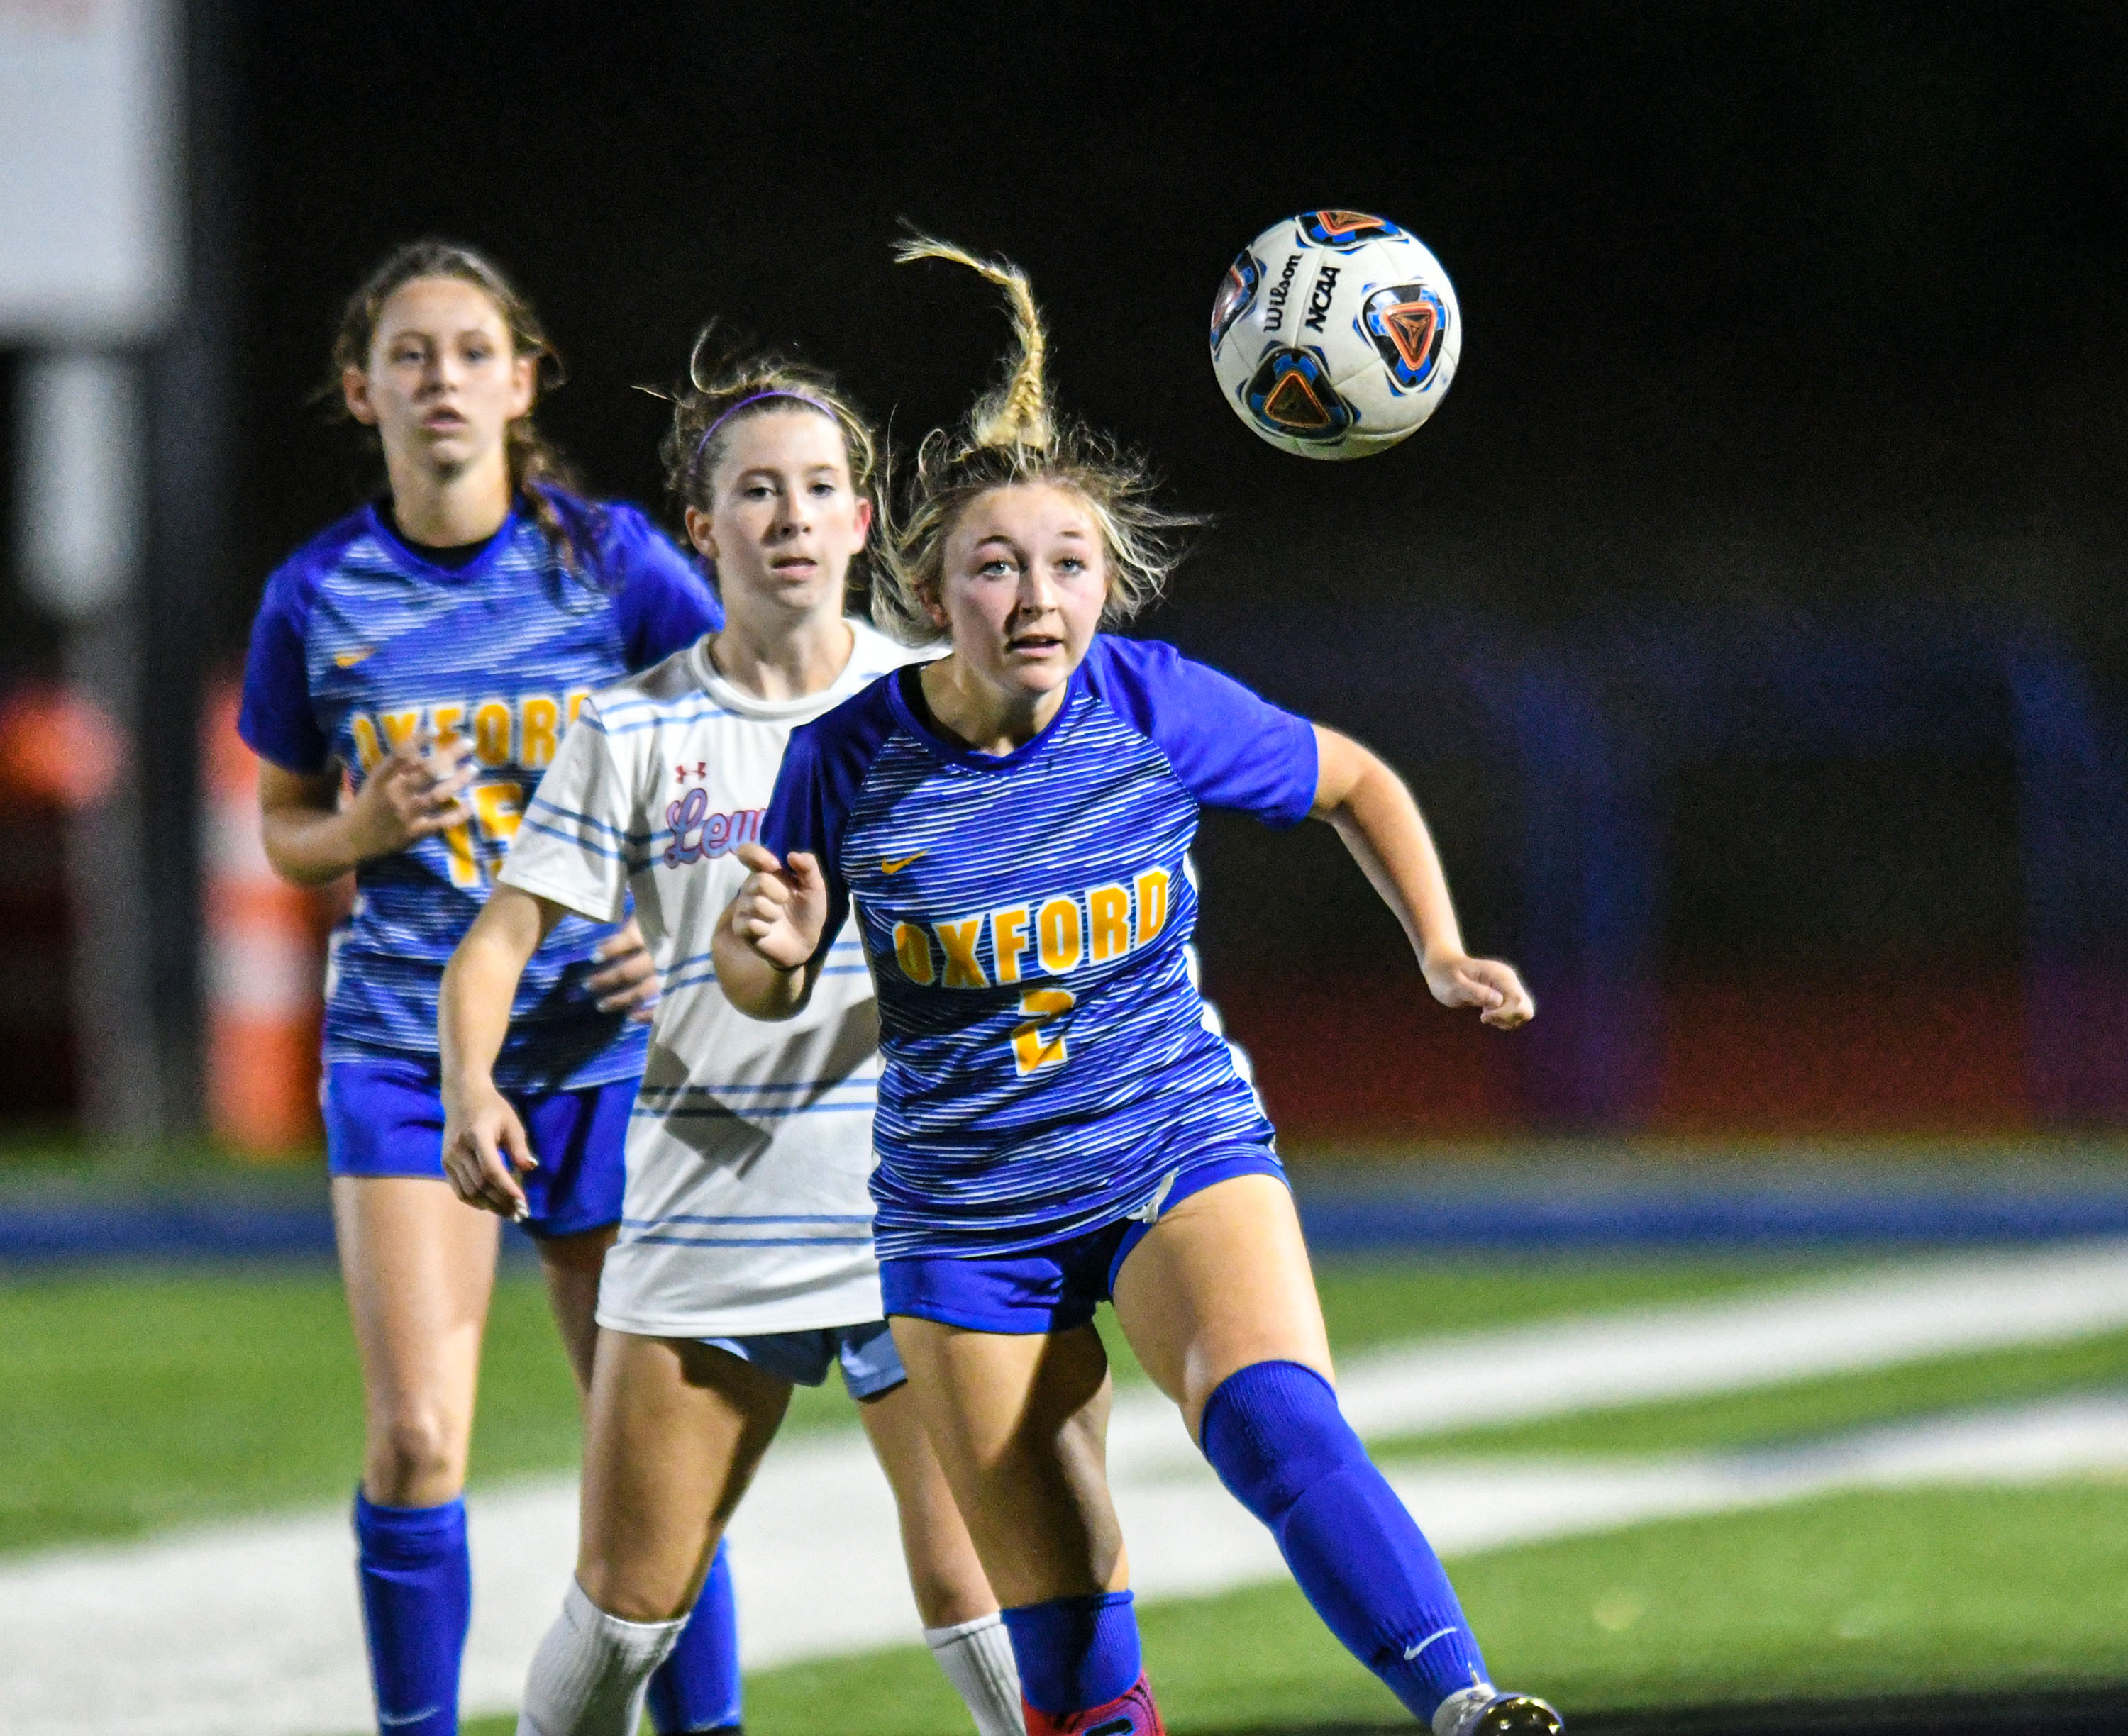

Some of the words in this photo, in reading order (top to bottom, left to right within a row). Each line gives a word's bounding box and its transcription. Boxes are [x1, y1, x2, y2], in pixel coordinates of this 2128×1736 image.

[1264, 252, 1304, 333] Wilson
[1304, 266, 1341, 334] NCAA
[892, 866, 1171, 989] OXFORD
[1010, 986, 1077, 1076] 2
